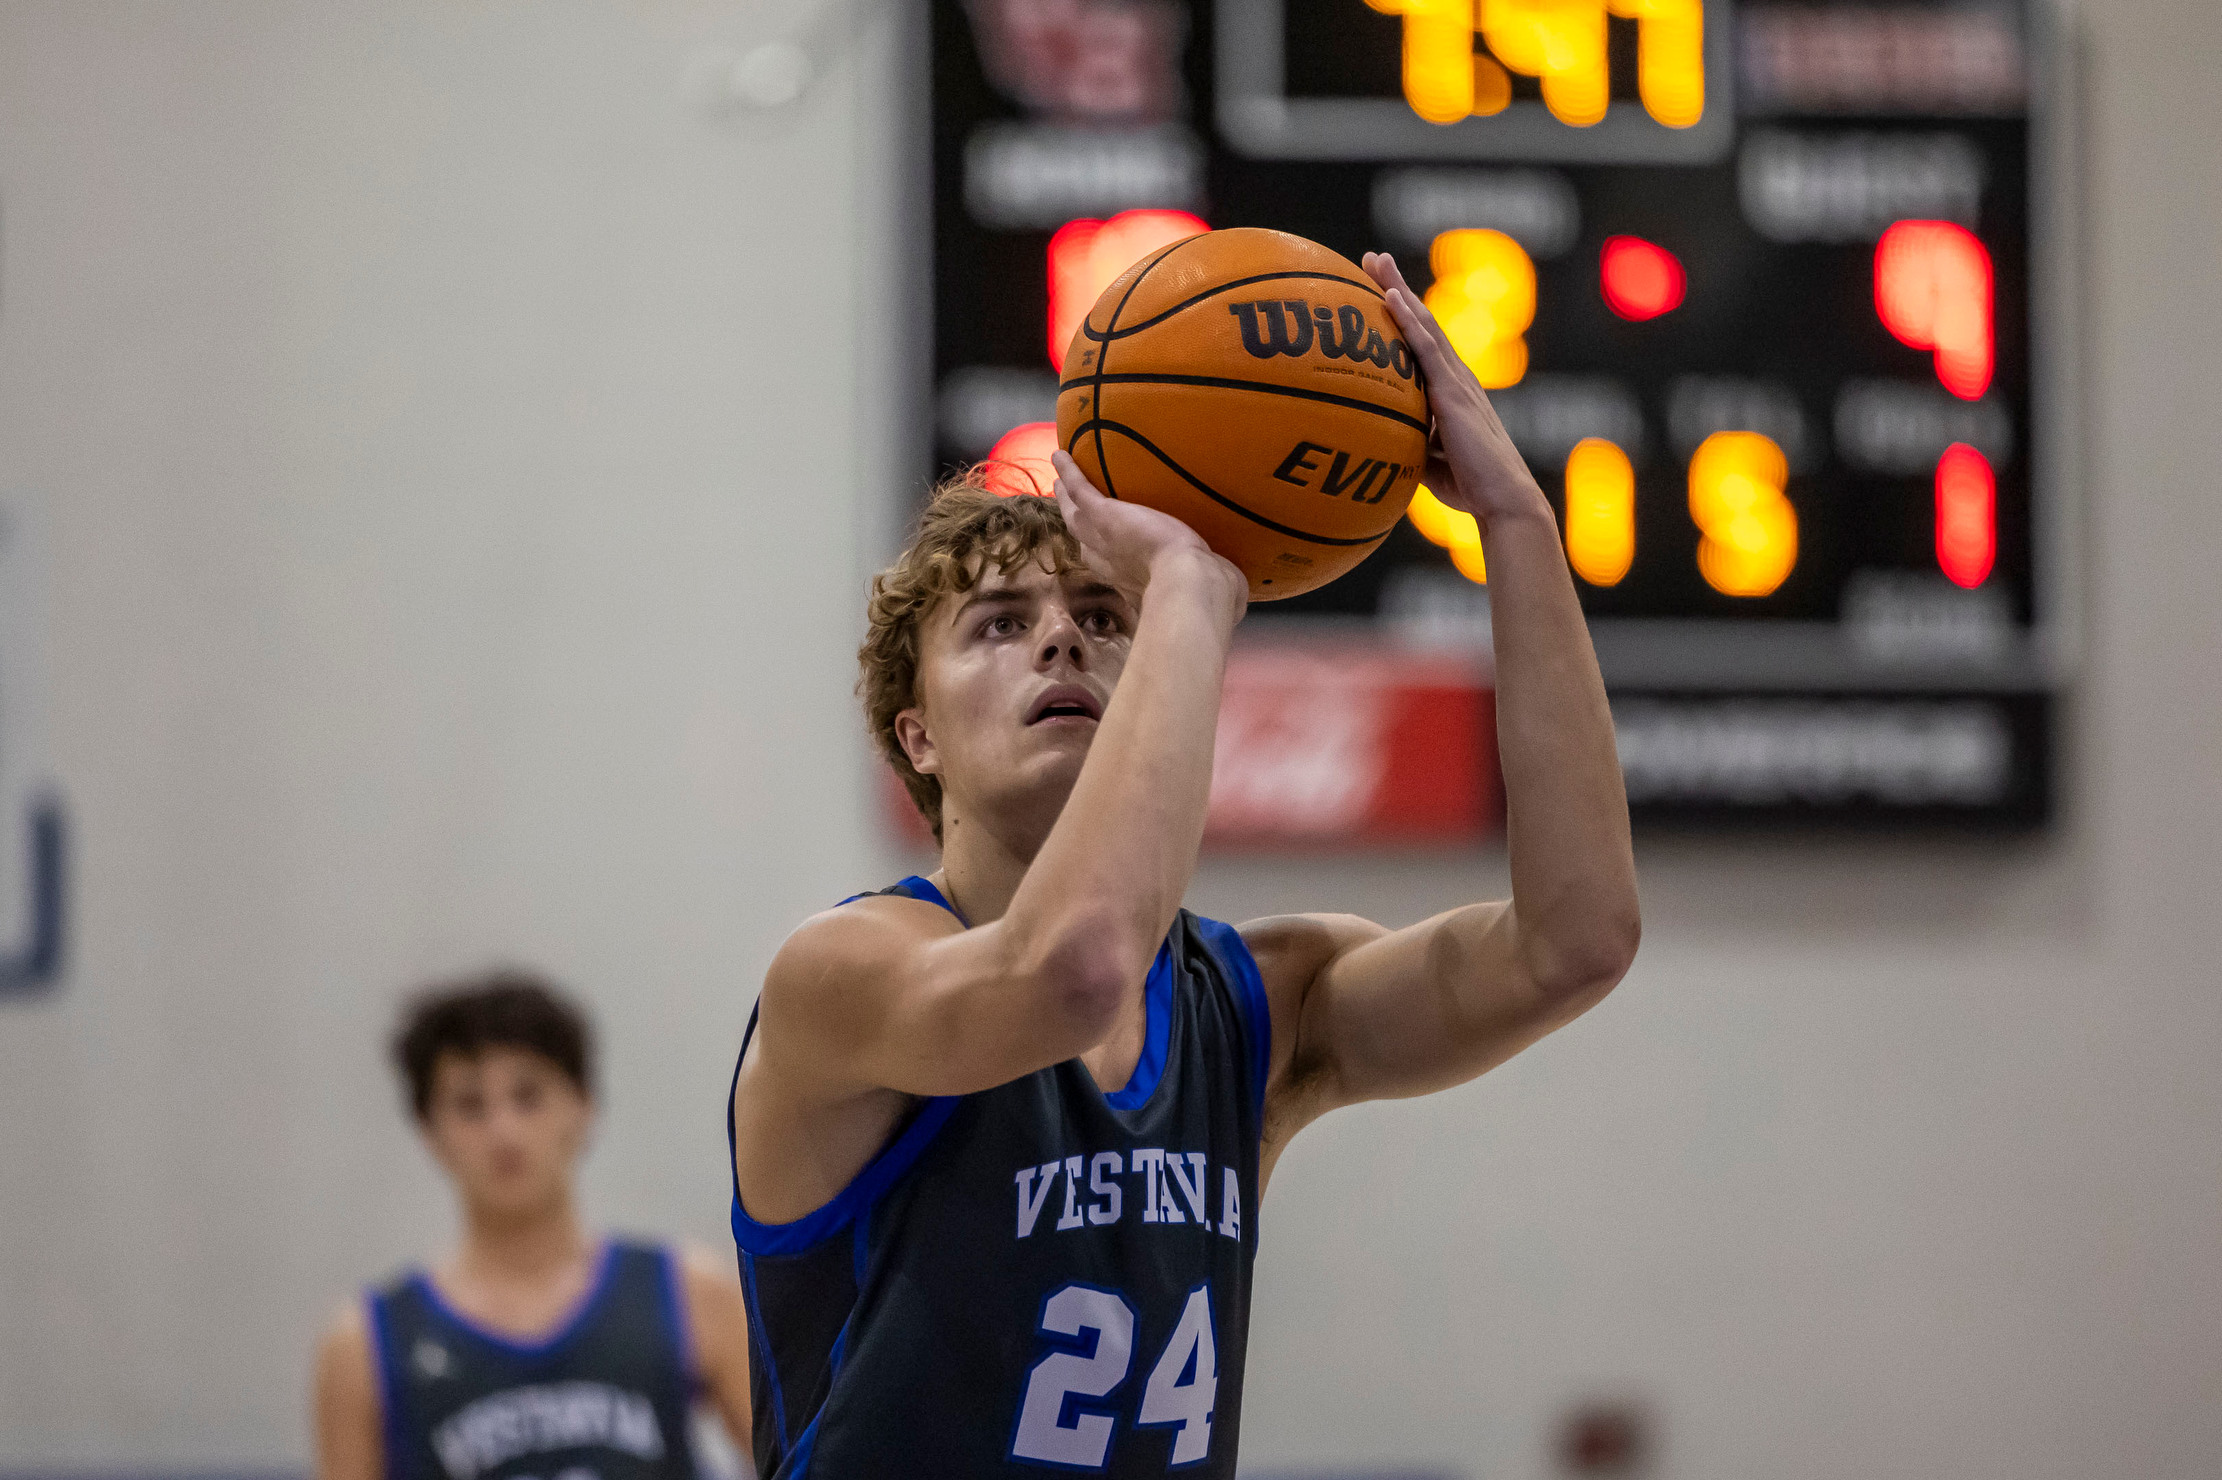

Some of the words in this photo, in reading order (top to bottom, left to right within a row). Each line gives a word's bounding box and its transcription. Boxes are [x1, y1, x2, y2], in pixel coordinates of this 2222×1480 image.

[1312, 366, 1355, 375] INDOOR
[1272, 441, 1401, 504] EVO
[1009, 1282, 1219, 1470] 24
